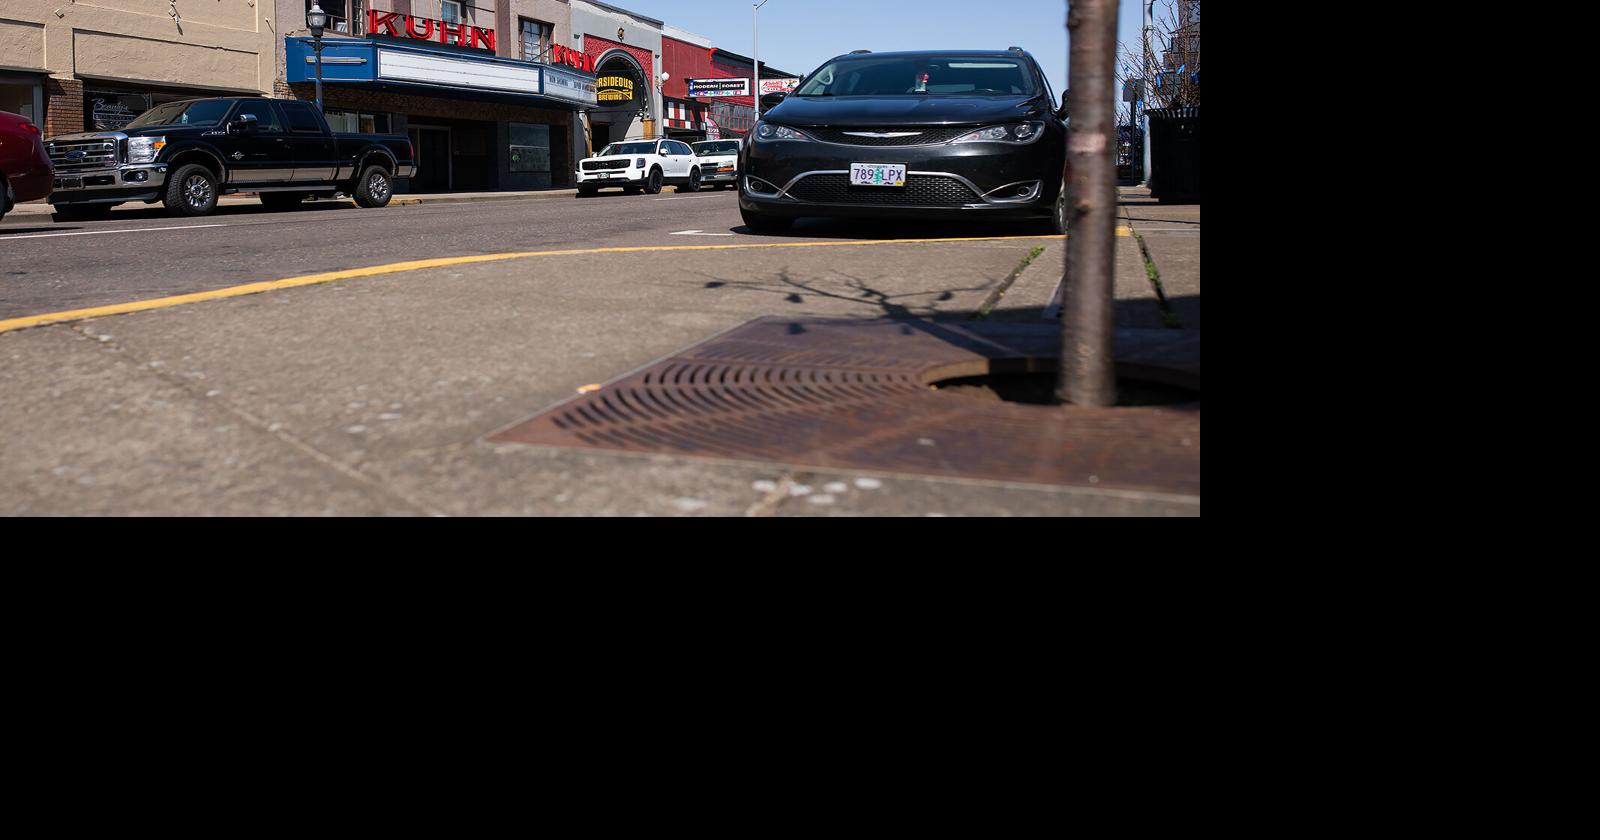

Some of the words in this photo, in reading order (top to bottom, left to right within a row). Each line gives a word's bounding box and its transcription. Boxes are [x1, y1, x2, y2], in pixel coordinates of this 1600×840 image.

[368, 9, 496, 51] KUHN
[553, 43, 595, 73] KUHN
[853, 168, 874, 180] 789
[881, 169, 903, 181] LPX
